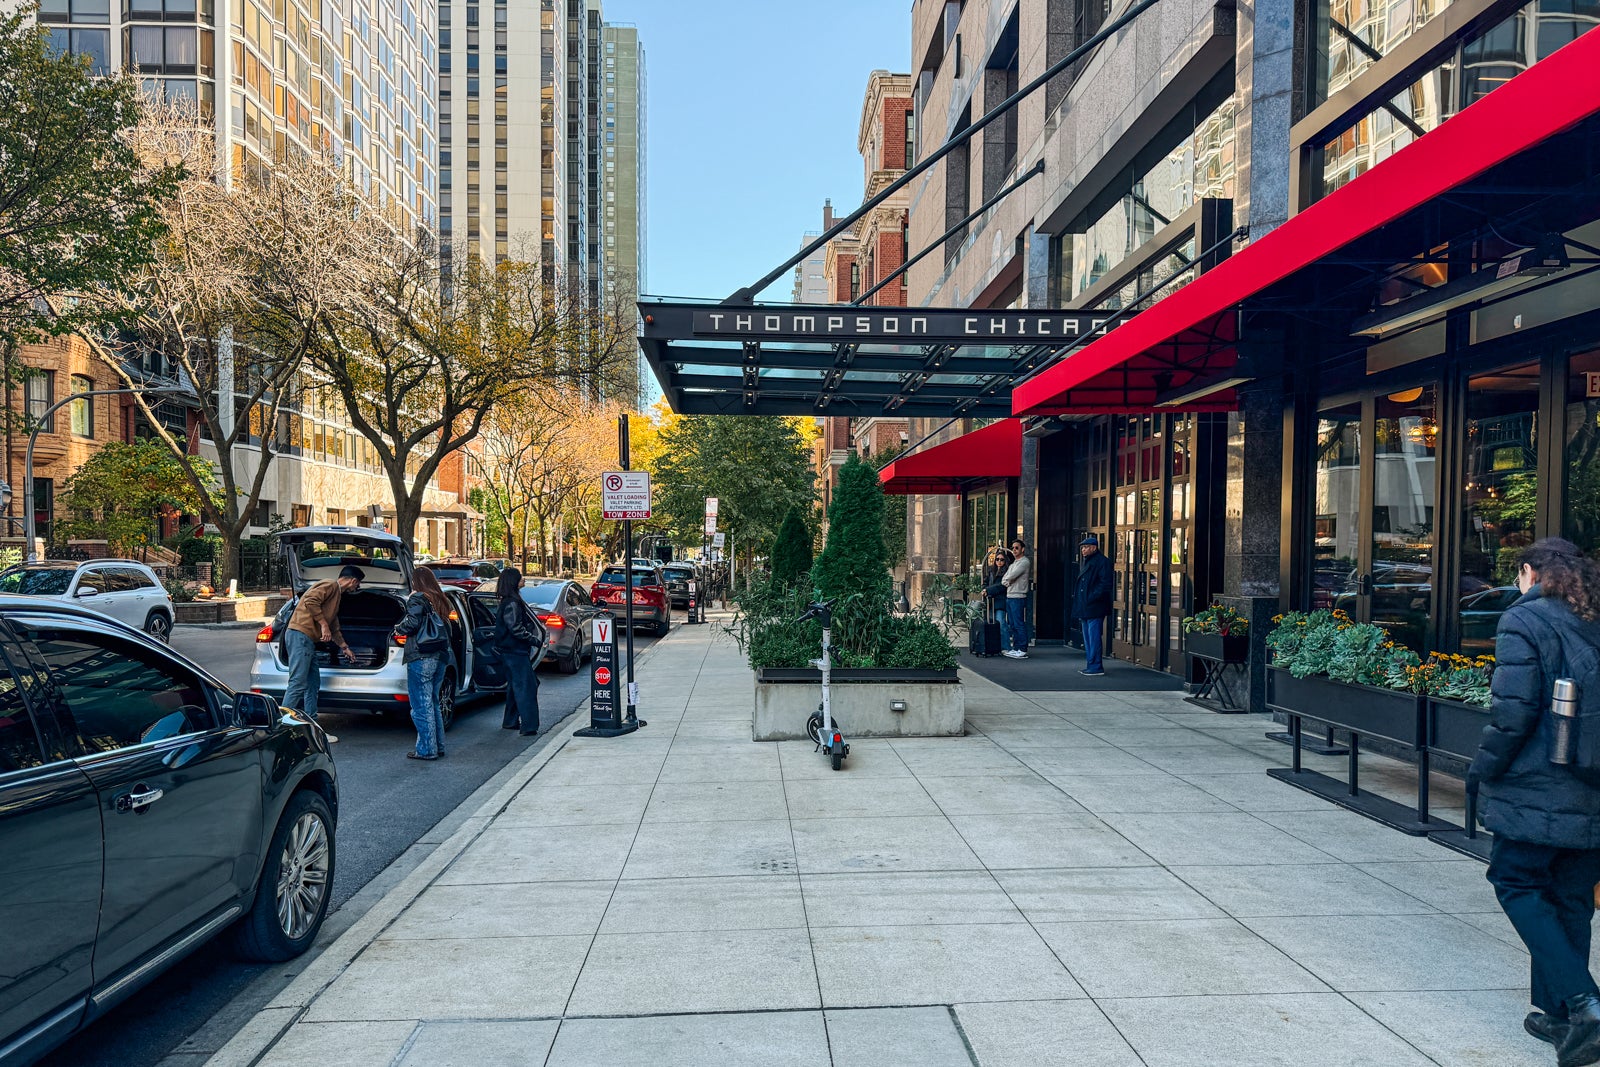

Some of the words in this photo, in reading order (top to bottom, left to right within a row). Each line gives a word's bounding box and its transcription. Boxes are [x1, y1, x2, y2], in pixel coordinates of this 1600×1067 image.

[709, 314, 927, 333] THOMPSON
[965, 318, 1131, 335] CHICAG
[598, 624, 608, 642] V
[595, 645, 611, 653] VALET
[595, 672, 611, 680] STOP
[594, 689, 611, 699] HERE
